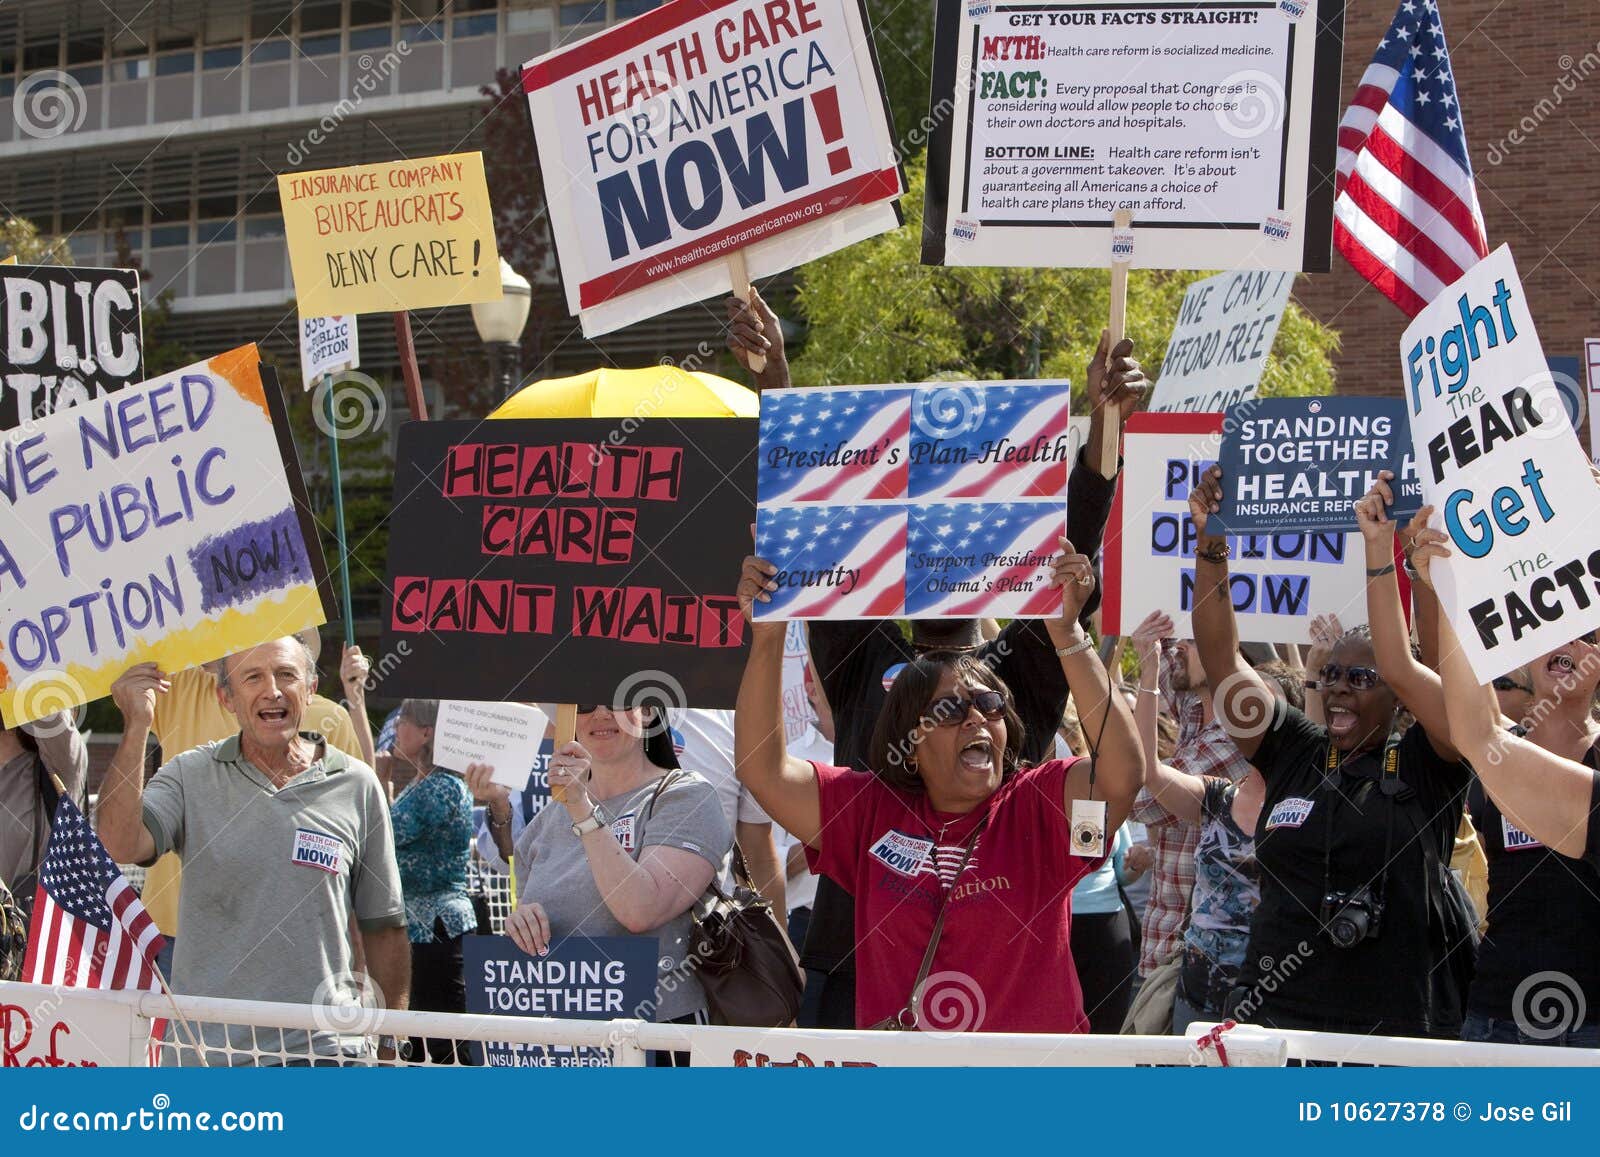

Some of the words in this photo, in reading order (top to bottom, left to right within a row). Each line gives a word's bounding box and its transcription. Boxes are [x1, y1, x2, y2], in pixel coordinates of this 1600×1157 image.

[1009, 14, 1043, 26] GET
[1048, 13, 1096, 26] YOUR
[1101, 12, 1156, 25] FACTS
[1161, 11, 1259, 24] STRAIGHT!
[982, 35, 1047, 61] MYTH:
[1047, 46, 1084, 57] Health
[1085, 48, 1110, 56] care
[1112, 45, 1149, 56] reform
[1151, 46, 1161, 56] is
[1163, 45, 1219, 56] socialized
[1221, 45, 1274, 56] medicine.
[576, 31, 707, 126] HEALTH
[715, 0, 822, 64] CARE
[979, 70, 1048, 99] FACT:
[1056, 83, 1090, 97] Every
[1093, 82, 1147, 98] proposal
[1150, 82, 1179, 94] that
[1183, 82, 1243, 97] Congress
[1246, 82, 1257, 94] is
[586, 112, 658, 174] FOR
[669, 40, 835, 142] AMERICA
[987, 100, 1057, 114] considering
[1059, 100, 1094, 111] would
[1097, 100, 1129, 111] allow
[1131, 99, 1172, 115] people
[1175, 100, 1189, 111] to
[1192, 99, 1238, 111] choose
[986, 117, 1016, 128] their
[1018, 119, 1042, 128] own
[1045, 117, 1095, 128] doctors
[1098, 116, 1121, 128] and
[1123, 116, 1186, 132] hospitals.
[985, 146, 1049, 158] BOTTOM
[1054, 146, 1095, 158] LINE:
[1109, 147, 1151, 159] Health
[1153, 150, 1181, 159] care
[1184, 147, 1228, 159] reform
[1230, 147, 1261, 159] isn't
[289, 172, 379, 201] INSURANCE
[388, 161, 464, 190] COMPANY
[597, 85, 852, 262] NOW!
[983, 164, 1019, 175] about
[1021, 166, 1029, 175] a
[1031, 164, 1105, 178] government
[1107, 164, 1165, 175] takeover.
[1174, 163, 1196, 175] It's
[1198, 164, 1237, 176] about
[981, 180, 1062, 195] guaranteeing
[1064, 180, 1079, 192] all
[1080, 180, 1148, 192] Americans
[1150, 184, 1158, 192] a
[1160, 180, 1201, 193] choice
[1203, 181, 1218, 193] of
[314, 191, 465, 236] BUREAUCRATS
[981, 196, 1020, 209] health
[1022, 200, 1049, 209] care
[1051, 197, 1085, 212] plans
[1087, 198, 1117, 212] they
[1118, 200, 1141, 210] can
[1143, 198, 1187, 210] afford.
[646, 201, 823, 277] www.healthcareforamericanow.org
[952, 227, 976, 241] NOW!
[1263, 225, 1290, 240] NOW!
[326, 246, 378, 288] DENY
[1180, 285, 1214, 326] WE
[1222, 271, 1287, 315] CAN
[312, 323, 349, 350] PUBLIC
[1160, 328, 1221, 377] AFFORD
[1217, 314, 1276, 368] FREE
[1408, 277, 1518, 418] Fight
[312, 338, 350, 365] OPTION
[1446, 383, 1486, 419] The
[79, 374, 216, 471] NEED
[1240, 416, 1392, 441] STANDING
[1428, 386, 1544, 485] FEAR
[768, 440, 900, 469] President's
[1240, 439, 1389, 465] TOGETHER
[447, 446, 680, 498] HEALTH
[49, 446, 236, 577] PUBLIC
[1236, 501, 1321, 516] INSURANCE
[1324, 499, 1360, 512] REF
[1444, 458, 1556, 559] Get
[482, 506, 635, 562] CARE
[1152, 516, 1344, 561] OPION
[211, 528, 300, 593] NOW!
[982, 549, 1053, 568] President
[1503, 549, 1554, 583] The
[775, 562, 861, 595] ecurity
[926, 576, 993, 593] Obama's
[8, 554, 185, 672] OPTION
[396, 580, 553, 633] CANT
[576, 588, 743, 646] WAIT
[1269, 811, 1306, 824] NOW!
[299, 833, 324, 845] HEALTH
[889, 833, 913, 847] HEALTH
[914, 841, 929, 852] CARE
[296, 847, 339, 869] NOW!
[874, 844, 921, 874] NOW!
[949, 875, 1011, 902] ation
[484, 959, 626, 985] STANDING
[485, 986, 624, 1012] TOGETHER
[561, 1056, 609, 1067] REFOR
